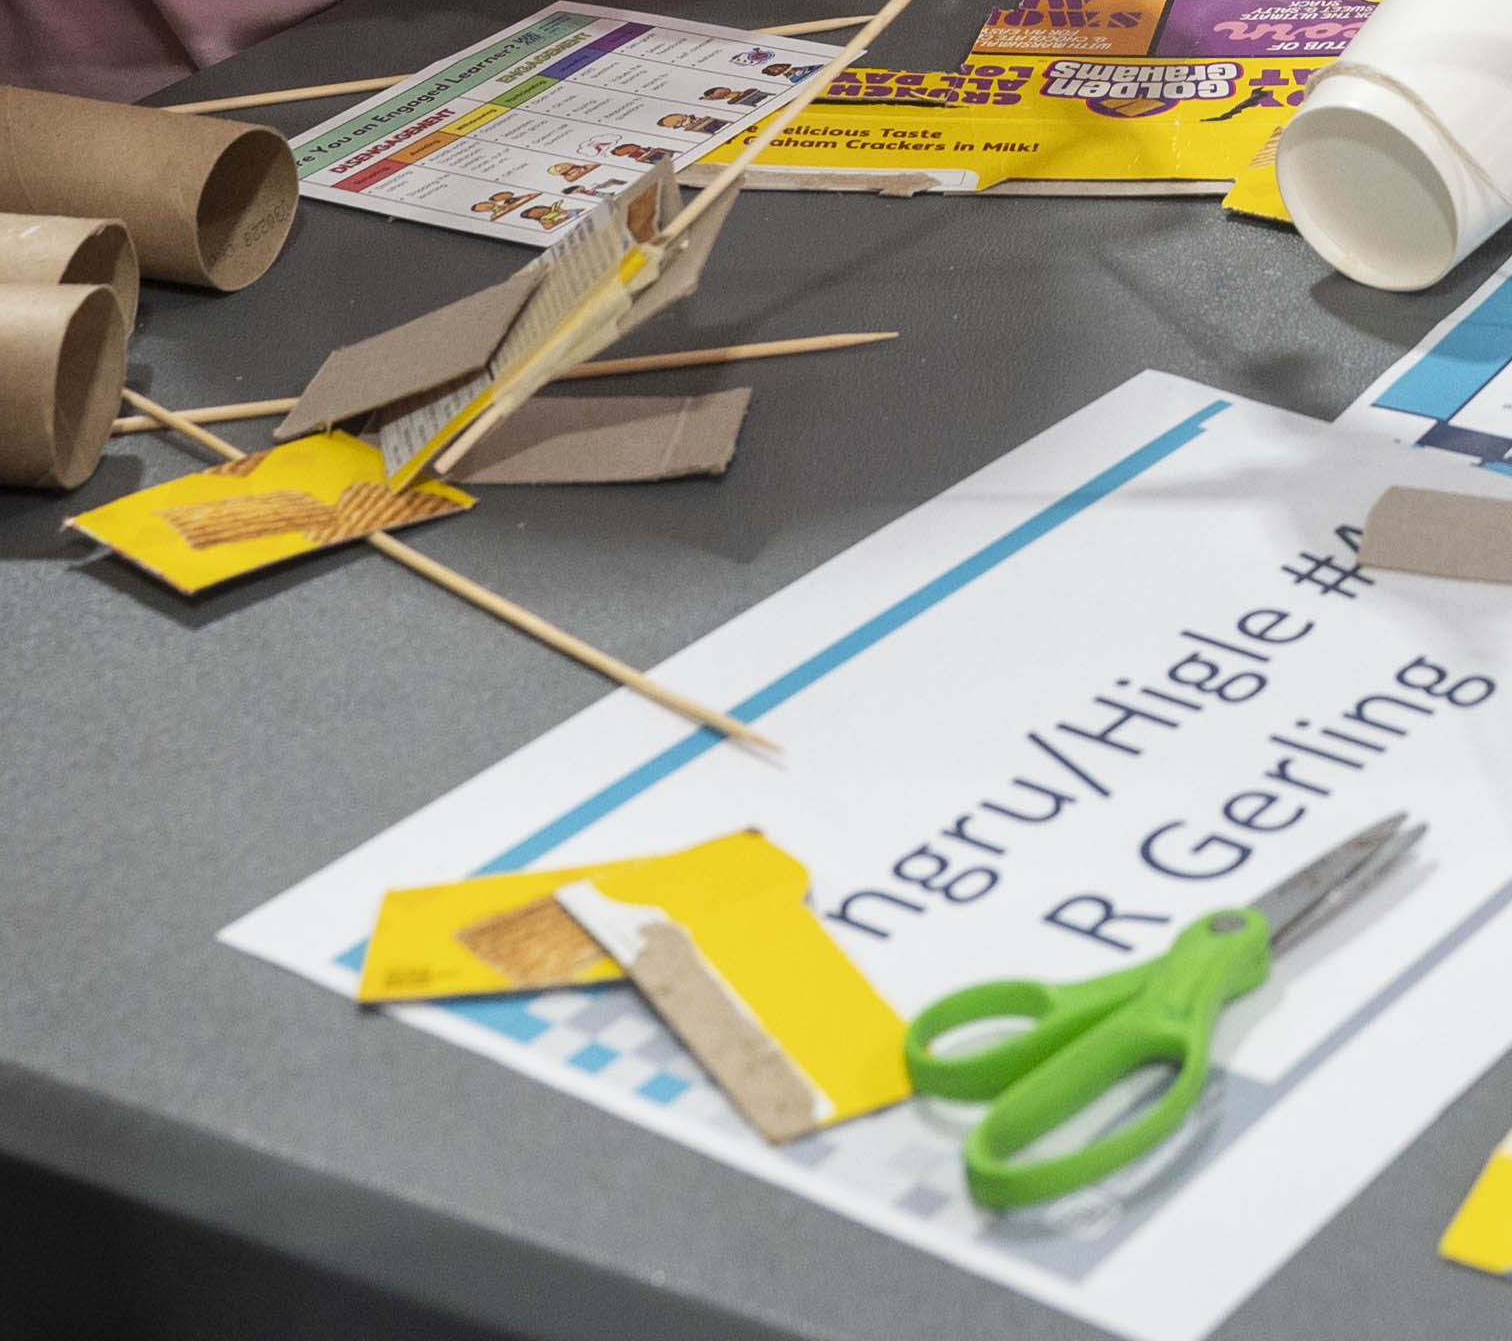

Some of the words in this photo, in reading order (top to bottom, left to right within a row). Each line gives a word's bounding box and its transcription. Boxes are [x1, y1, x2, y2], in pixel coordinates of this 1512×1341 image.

[1265, 41, 1299, 51] OF
[1303, 40, 1345, 51] TUB
[940, 75, 1028, 92] ALL
[306, 134, 356, 155] You
[345, 122, 380, 136] an
[366, 82, 459, 124] Engaged
[436, 43, 528, 83] Learner?
[325, 107, 461, 174] DISENGAGEMENT
[487, 31, 600, 84] ENGAGEMENT
[783, 124, 871, 138] elicious
[880, 128, 943, 140] Taste
[846, 139, 946, 152] Crackers
[953, 140, 974, 152] in
[982, 141, 1041, 153] Milk!
[827, 602, 1317, 942] ngru/Higle
[1043, 893, 1171, 955] R
[1138, 652, 1498, 883] Gerling
